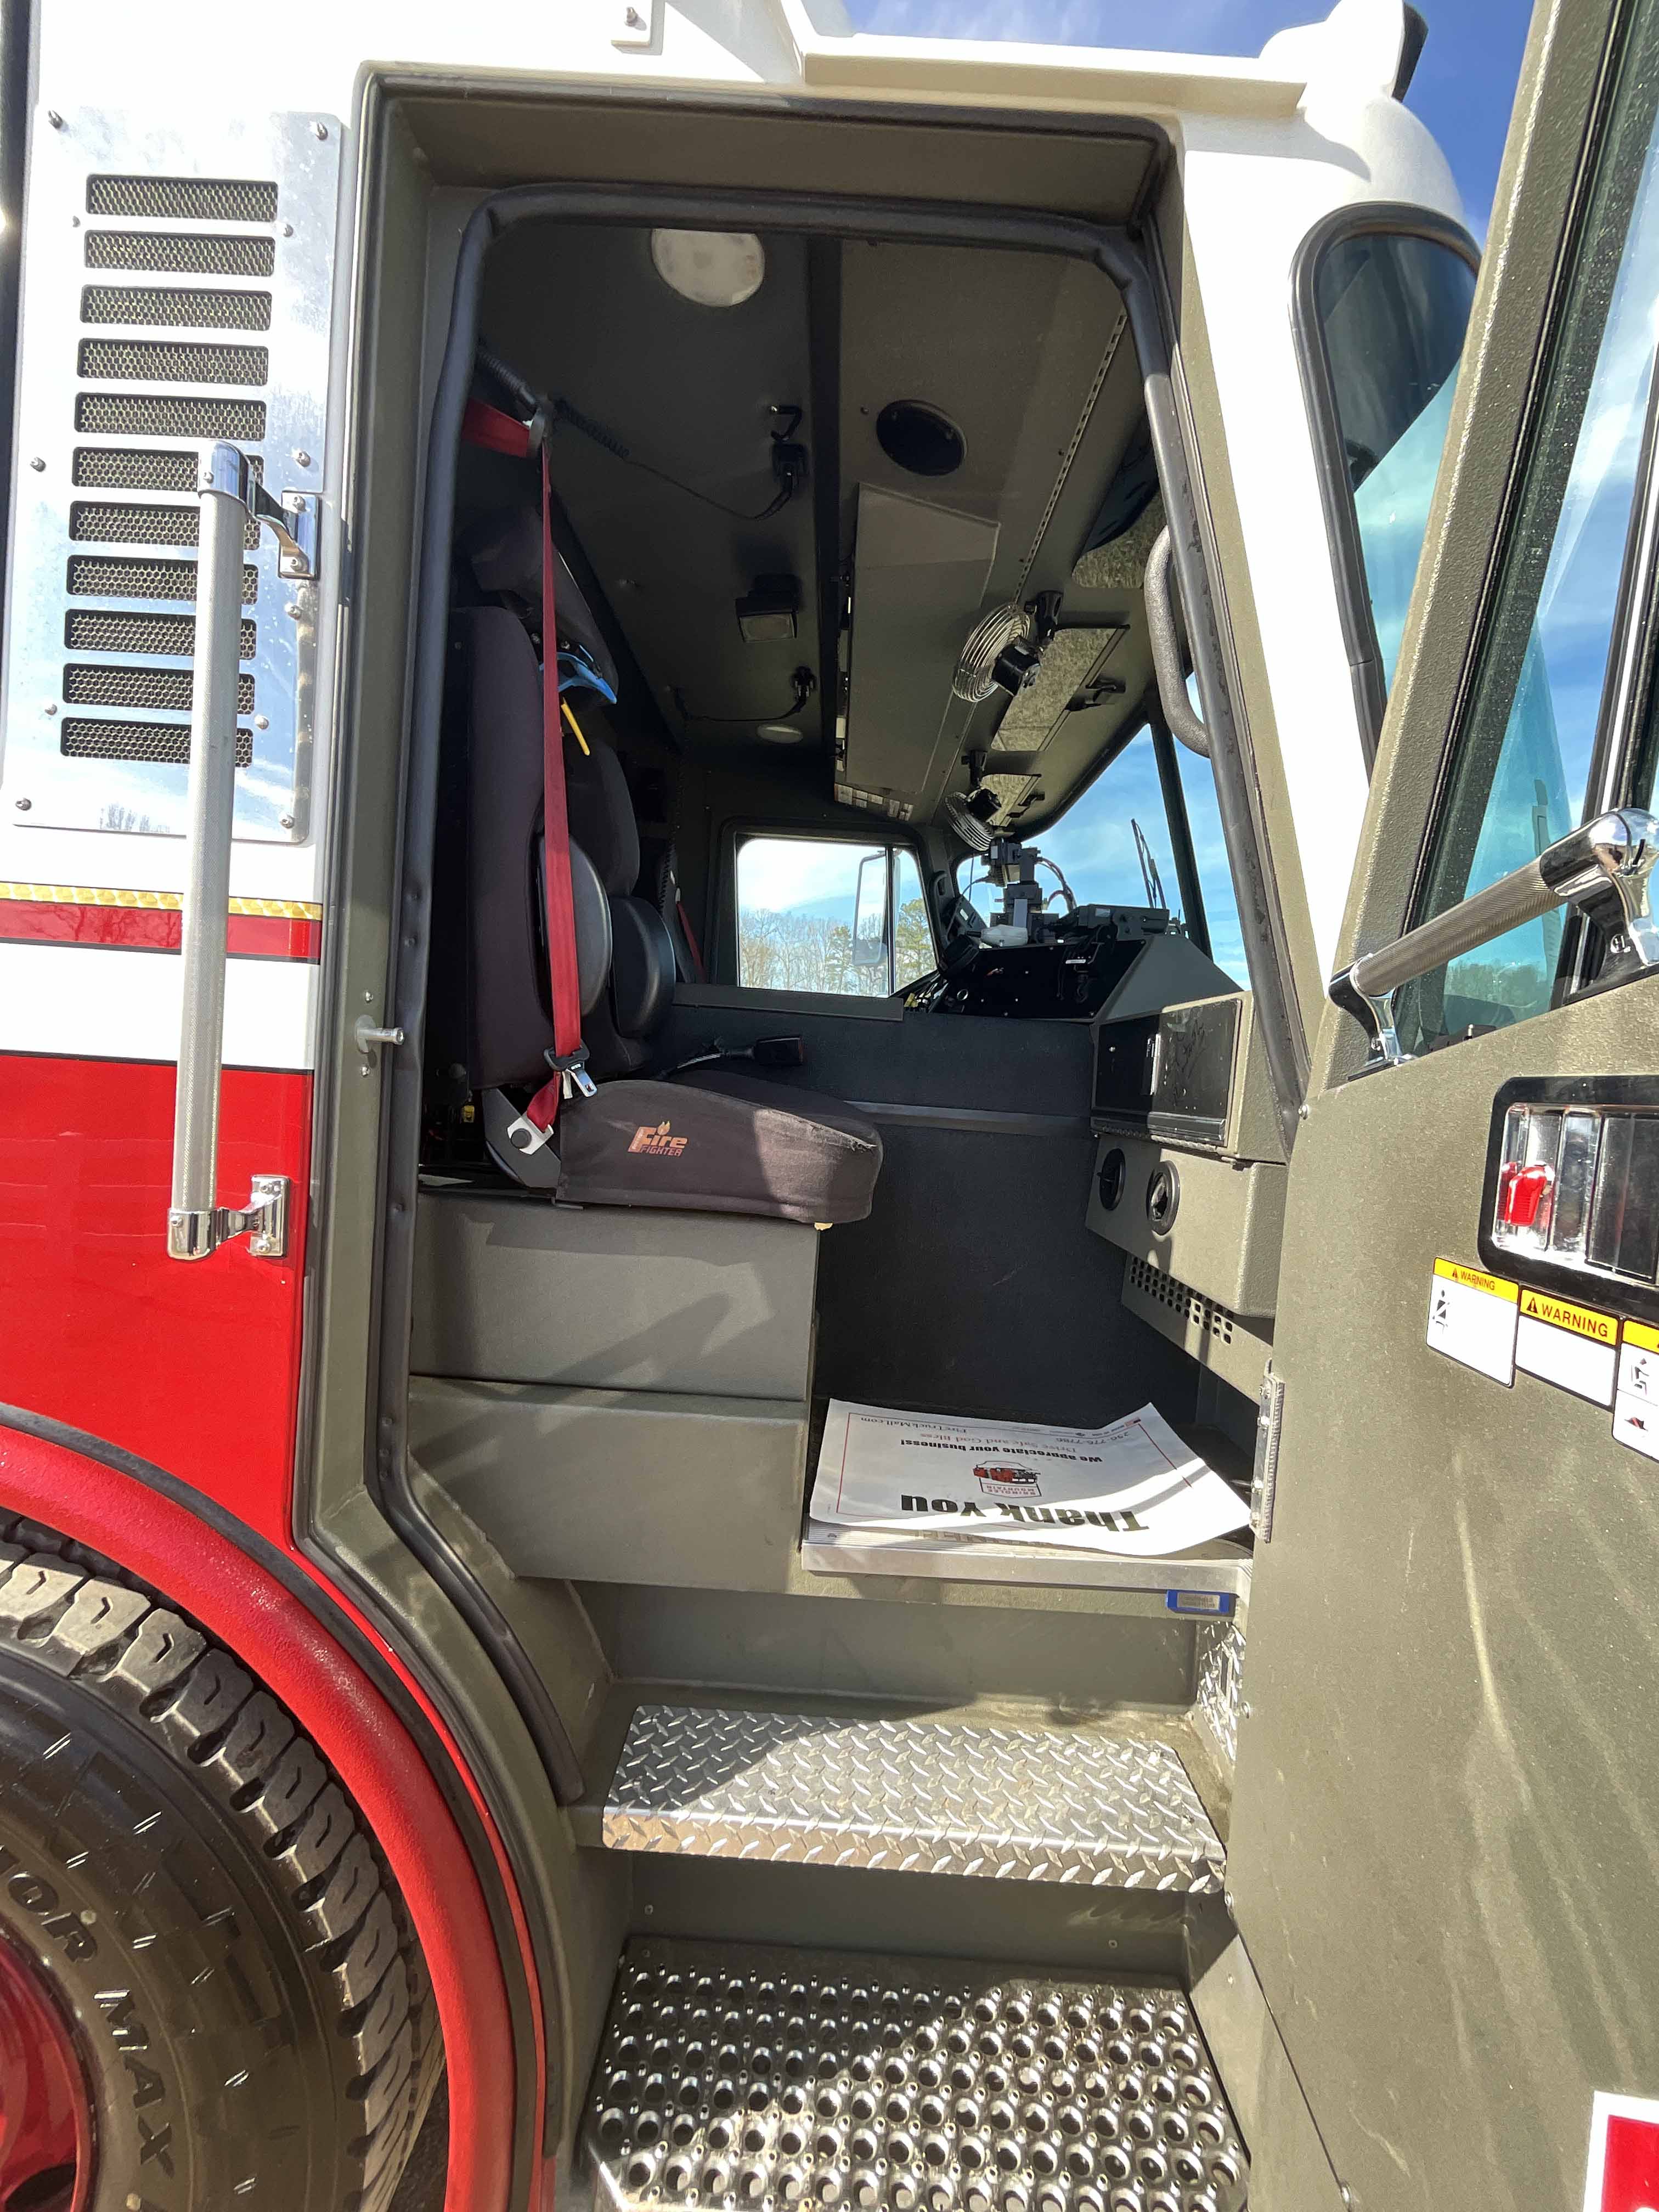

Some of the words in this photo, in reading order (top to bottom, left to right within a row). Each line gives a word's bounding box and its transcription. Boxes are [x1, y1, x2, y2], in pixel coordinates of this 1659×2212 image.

[628, 1125, 688, 1153] Fire
[640, 1144, 683, 1157] FIGHTER
[1460, 1271, 1496, 1291] WARNING
[1542, 1302, 1609, 1338] WARNING
[920, 1432, 951, 1441] Bless
[956, 1435, 981, 1444] God
[900, 1439, 967, 1452] business!
[1002, 1447, 1077, 1461] appreciate
[994, 1502, 1150, 1532] Thank
[93, 1989, 175, 2179] MAX
